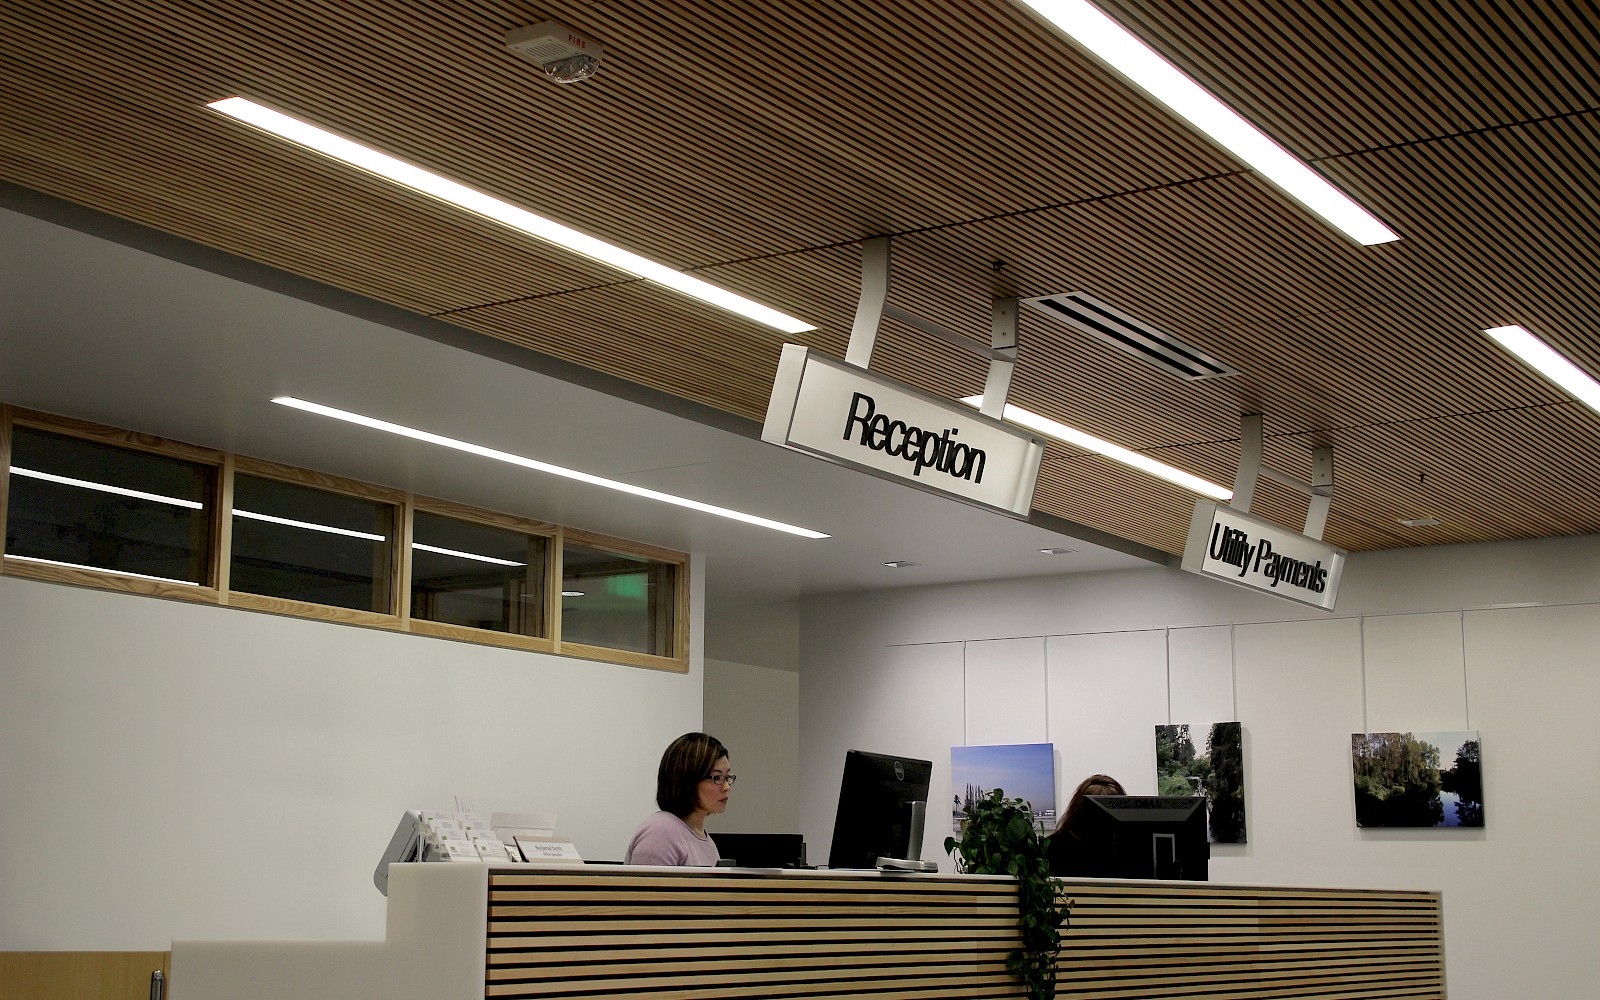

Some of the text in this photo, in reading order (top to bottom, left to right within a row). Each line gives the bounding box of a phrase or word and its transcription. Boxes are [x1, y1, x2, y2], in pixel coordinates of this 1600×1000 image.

[568, 34, 586, 49] FIRE
[843, 391, 986, 484] Reception
[1209, 522, 1327, 593] Utility Payments
